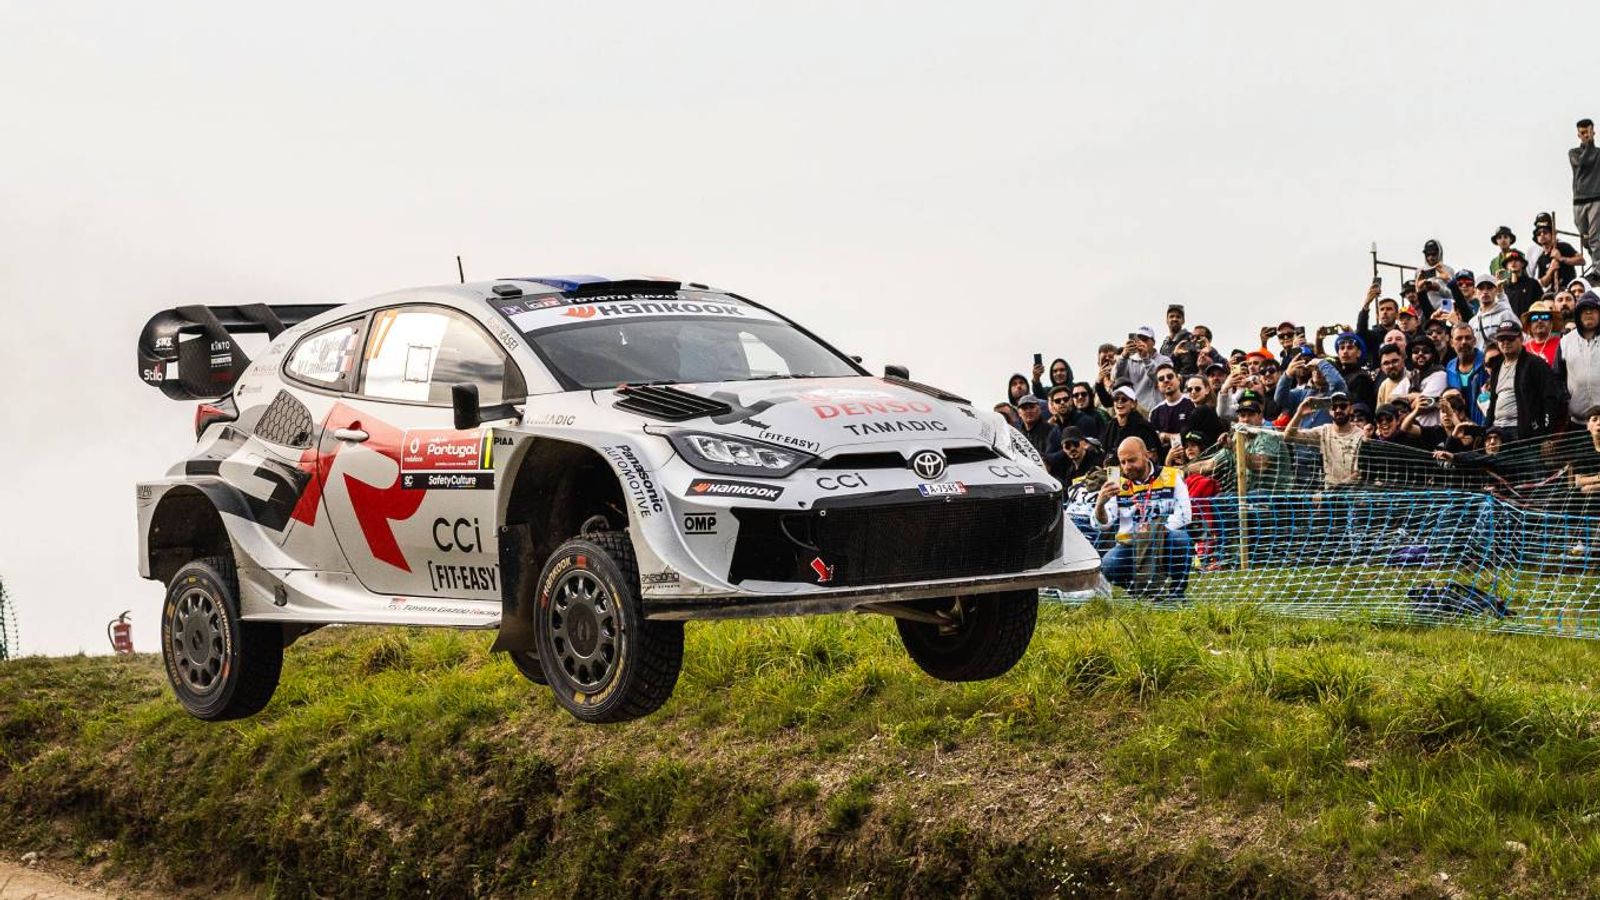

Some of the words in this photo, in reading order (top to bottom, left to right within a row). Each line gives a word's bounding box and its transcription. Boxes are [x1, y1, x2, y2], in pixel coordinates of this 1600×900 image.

[144, 364, 163, 381] Stilo
[813, 400, 933, 419] DENSO
[842, 420, 948, 436] TAMADIC
[494, 437, 514, 446] PIAA
[427, 443, 478, 458] Portugal
[428, 474, 477, 488] SafetyCulture
[600, 446, 652, 519] AUTOMOTIVE
[615, 444, 664, 513] Panasonic
[684, 517, 717, 531] OMP
